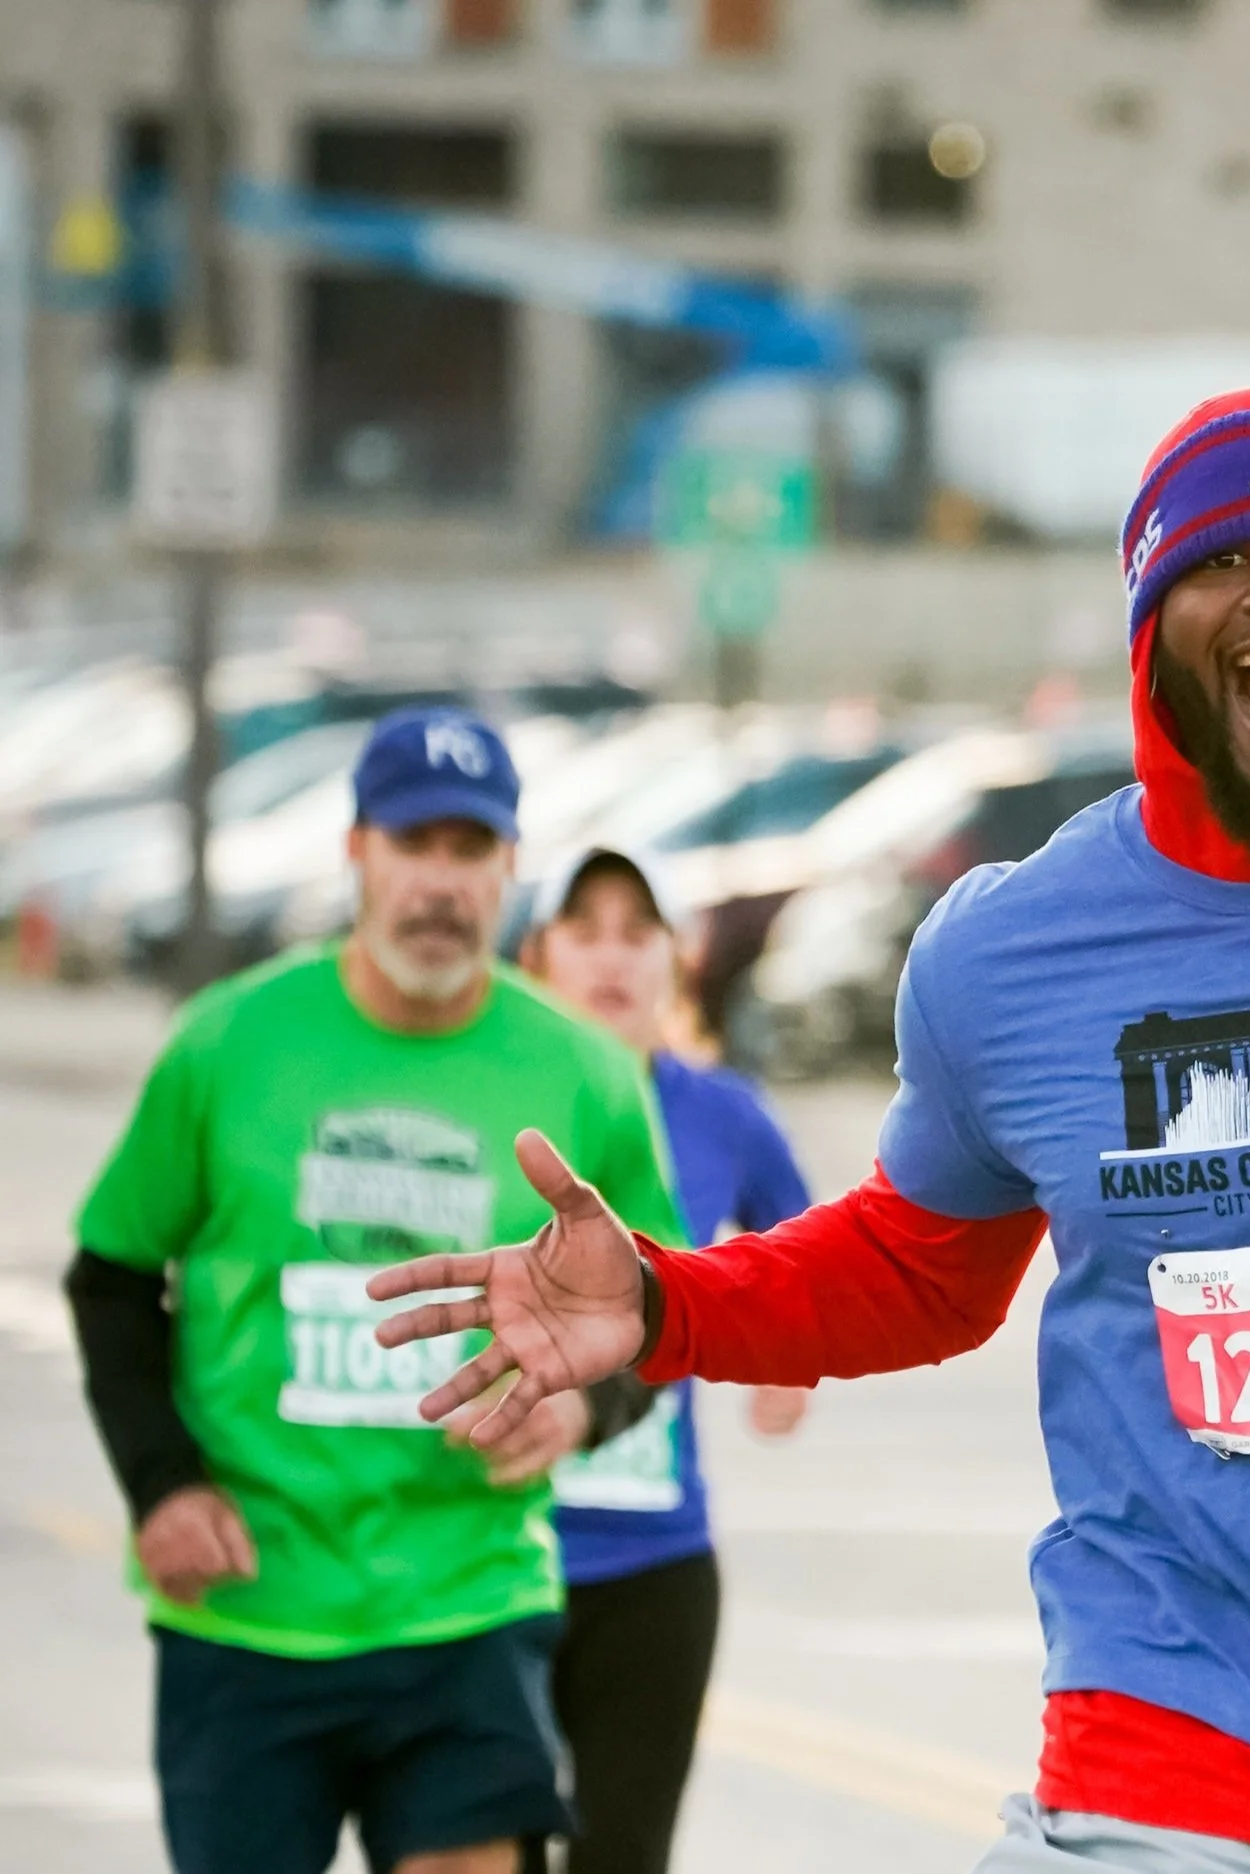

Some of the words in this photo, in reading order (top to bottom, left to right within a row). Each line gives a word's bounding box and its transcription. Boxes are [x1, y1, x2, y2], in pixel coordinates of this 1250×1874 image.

[1101, 1156, 1229, 1201] KANSAS
[1172, 1270, 1229, 1285] 10.20.2018
[1201, 1283, 1239, 1310] 5K
